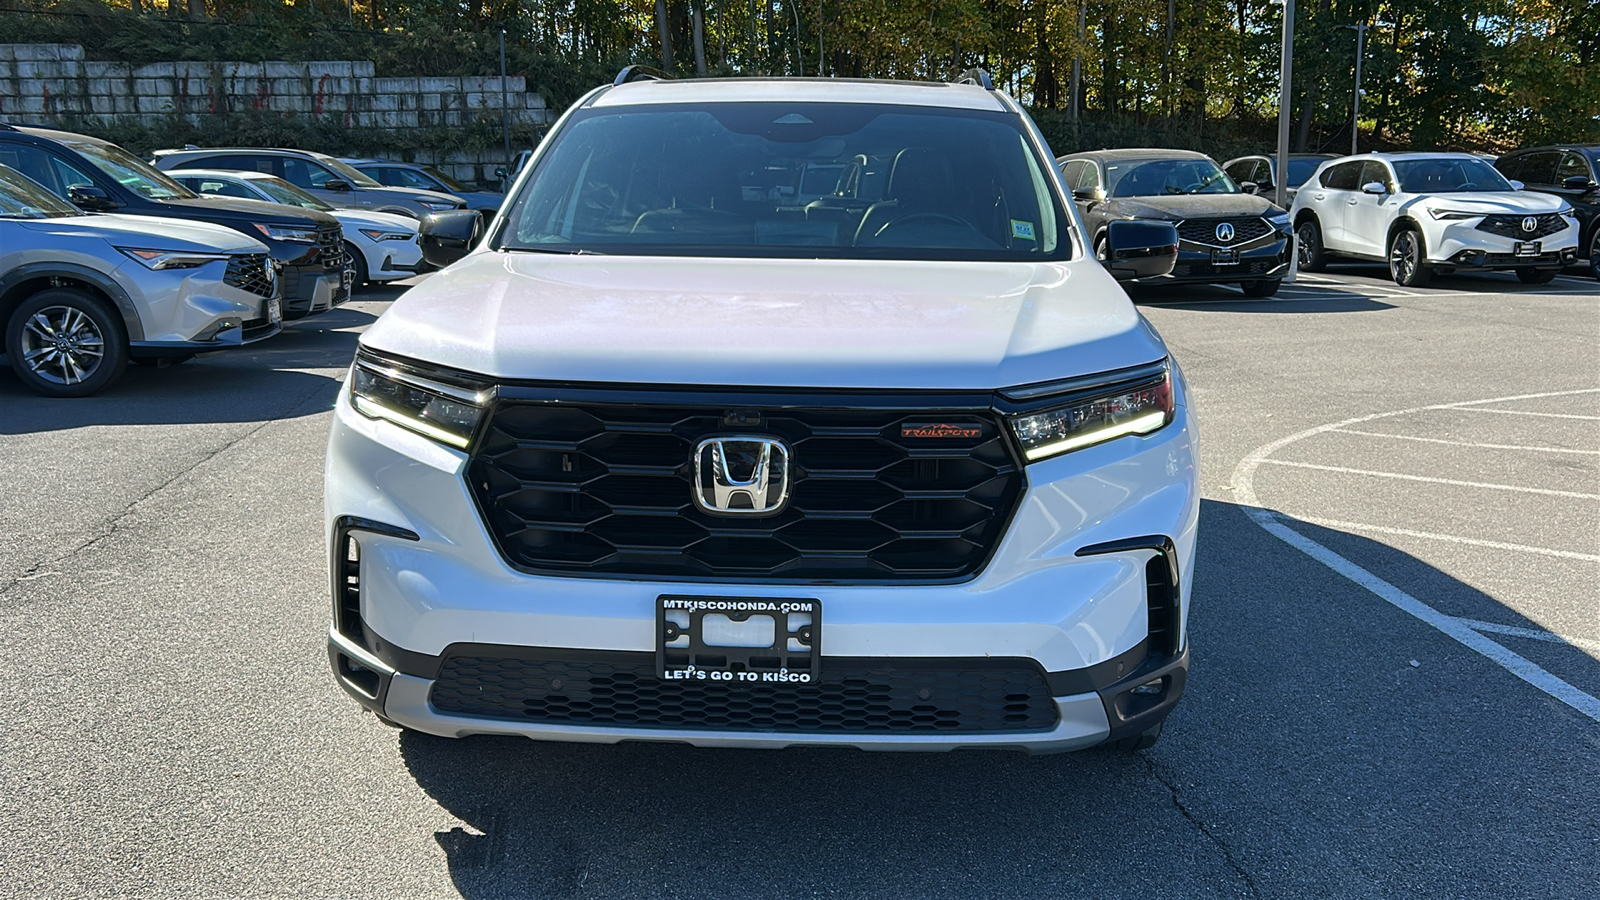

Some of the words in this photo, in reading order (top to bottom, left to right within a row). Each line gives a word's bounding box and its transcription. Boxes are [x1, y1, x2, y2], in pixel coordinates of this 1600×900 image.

[902, 429, 980, 437] TRAILSPORT
[663, 600, 813, 612] MTKISCOHONDA.COM
[664, 670, 706, 680] LET'S
[710, 671, 733, 681] GO
[737, 672, 759, 682] TO
[762, 672, 811, 683] KISCO
